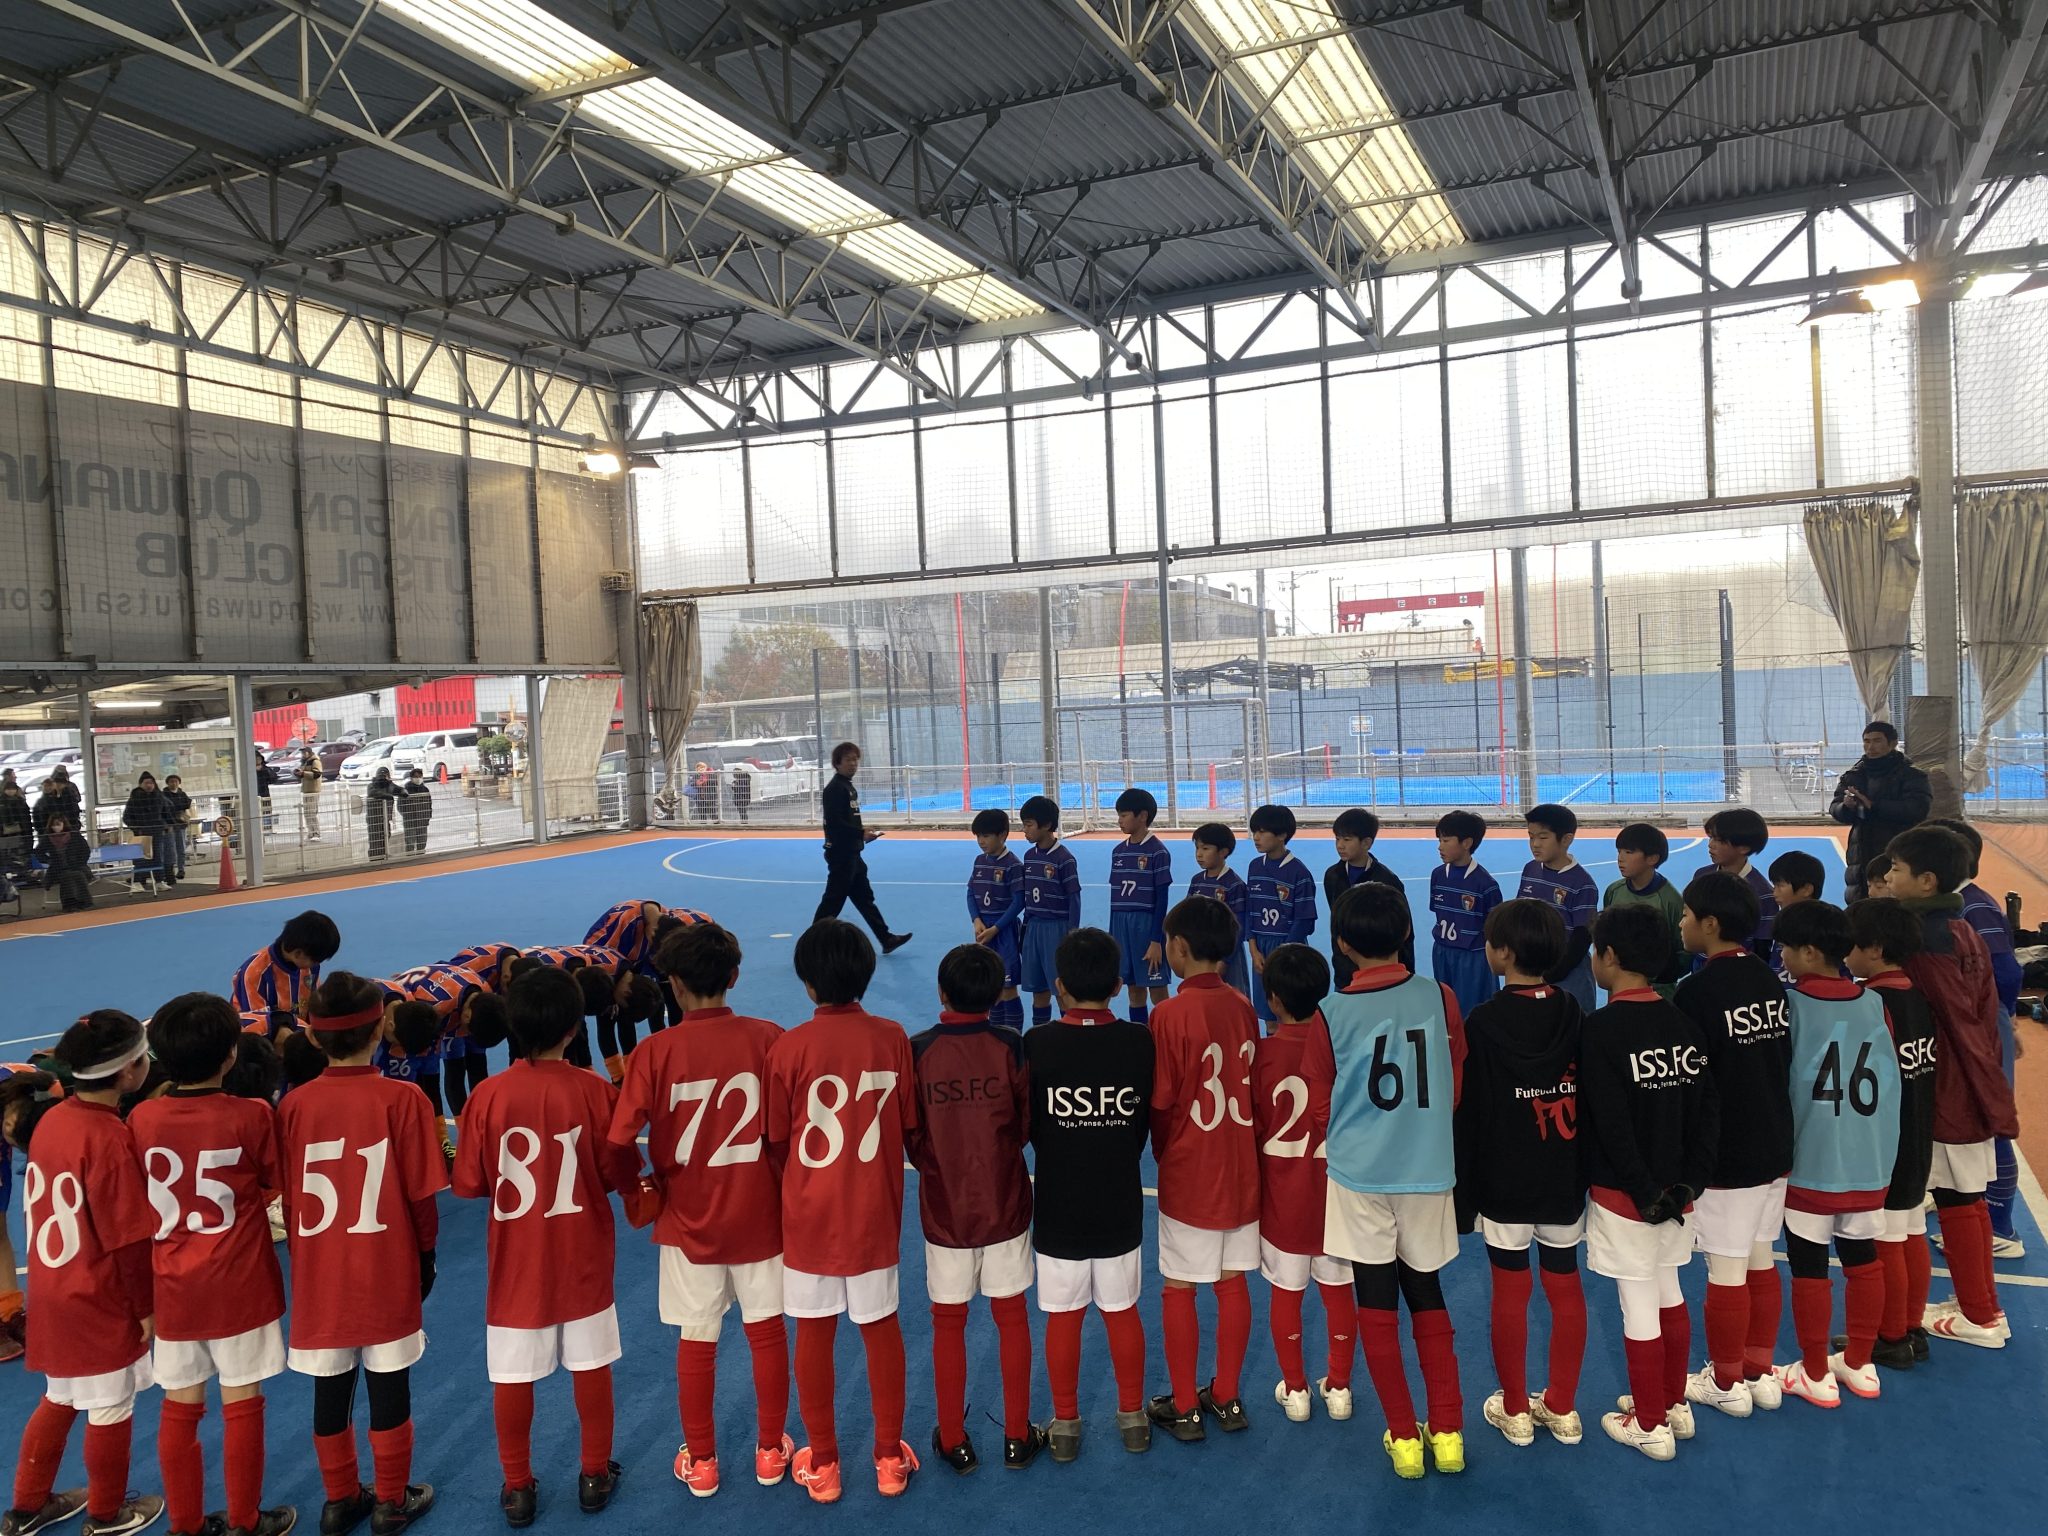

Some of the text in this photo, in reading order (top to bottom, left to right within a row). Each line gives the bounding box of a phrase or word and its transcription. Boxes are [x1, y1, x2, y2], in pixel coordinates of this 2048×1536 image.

[983, 891, 991, 906] 6
[1032, 887, 1040, 903] 8
[1121, 880, 1136, 896] 77
[1261, 907, 1280, 926] 39
[1440, 919, 1457, 941] 16
[388, 1058, 411, 1078] 26
[1368, 1028, 1430, 1112] 61
[1811, 1040, 1879, 1117] 46
[669, 1071, 762, 1168] 72
[798, 1070, 899, 1169] 87
[1047, 1086, 1135, 1117] ISS.F.C
[1262, 1075, 1327, 1159] 2
[298, 1137, 389, 1237] 51
[493, 1124, 583, 1222] 81
